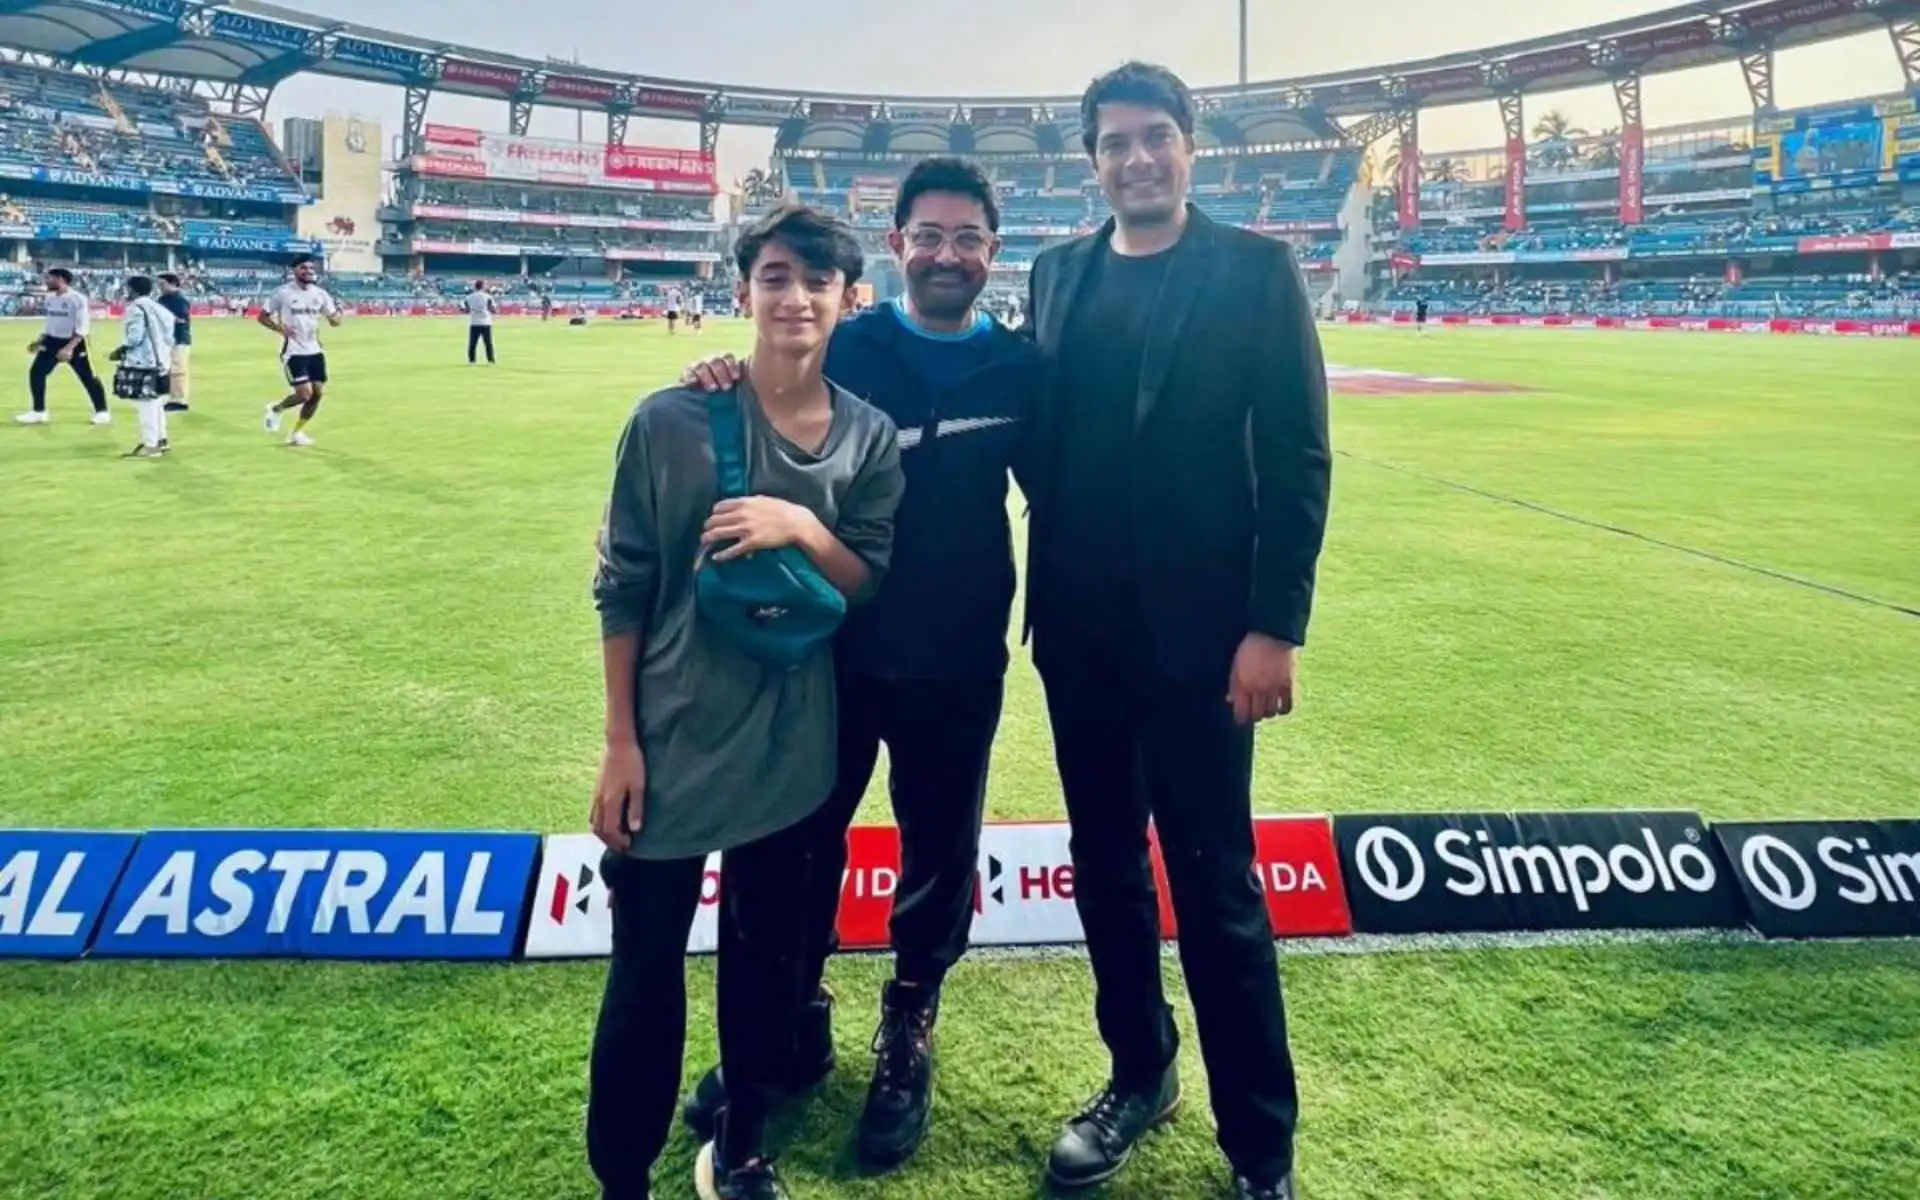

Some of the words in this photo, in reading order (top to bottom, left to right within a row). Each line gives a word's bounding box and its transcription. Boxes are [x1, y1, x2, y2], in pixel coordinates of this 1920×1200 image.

[217, 14, 303, 41] ADVANCE
[507, 144, 599, 168] FREEMANS
[628, 154, 714, 175] FREEMANS
[62, 171, 140, 189] ADVANCE
[203, 185, 272, 200] ADVANCE
[209, 236, 276, 250] ADVANCE
[1255, 862, 1327, 892] IDA
[1434, 828, 1716, 911] Simpolo
[114, 849, 504, 935] ASTRAL
